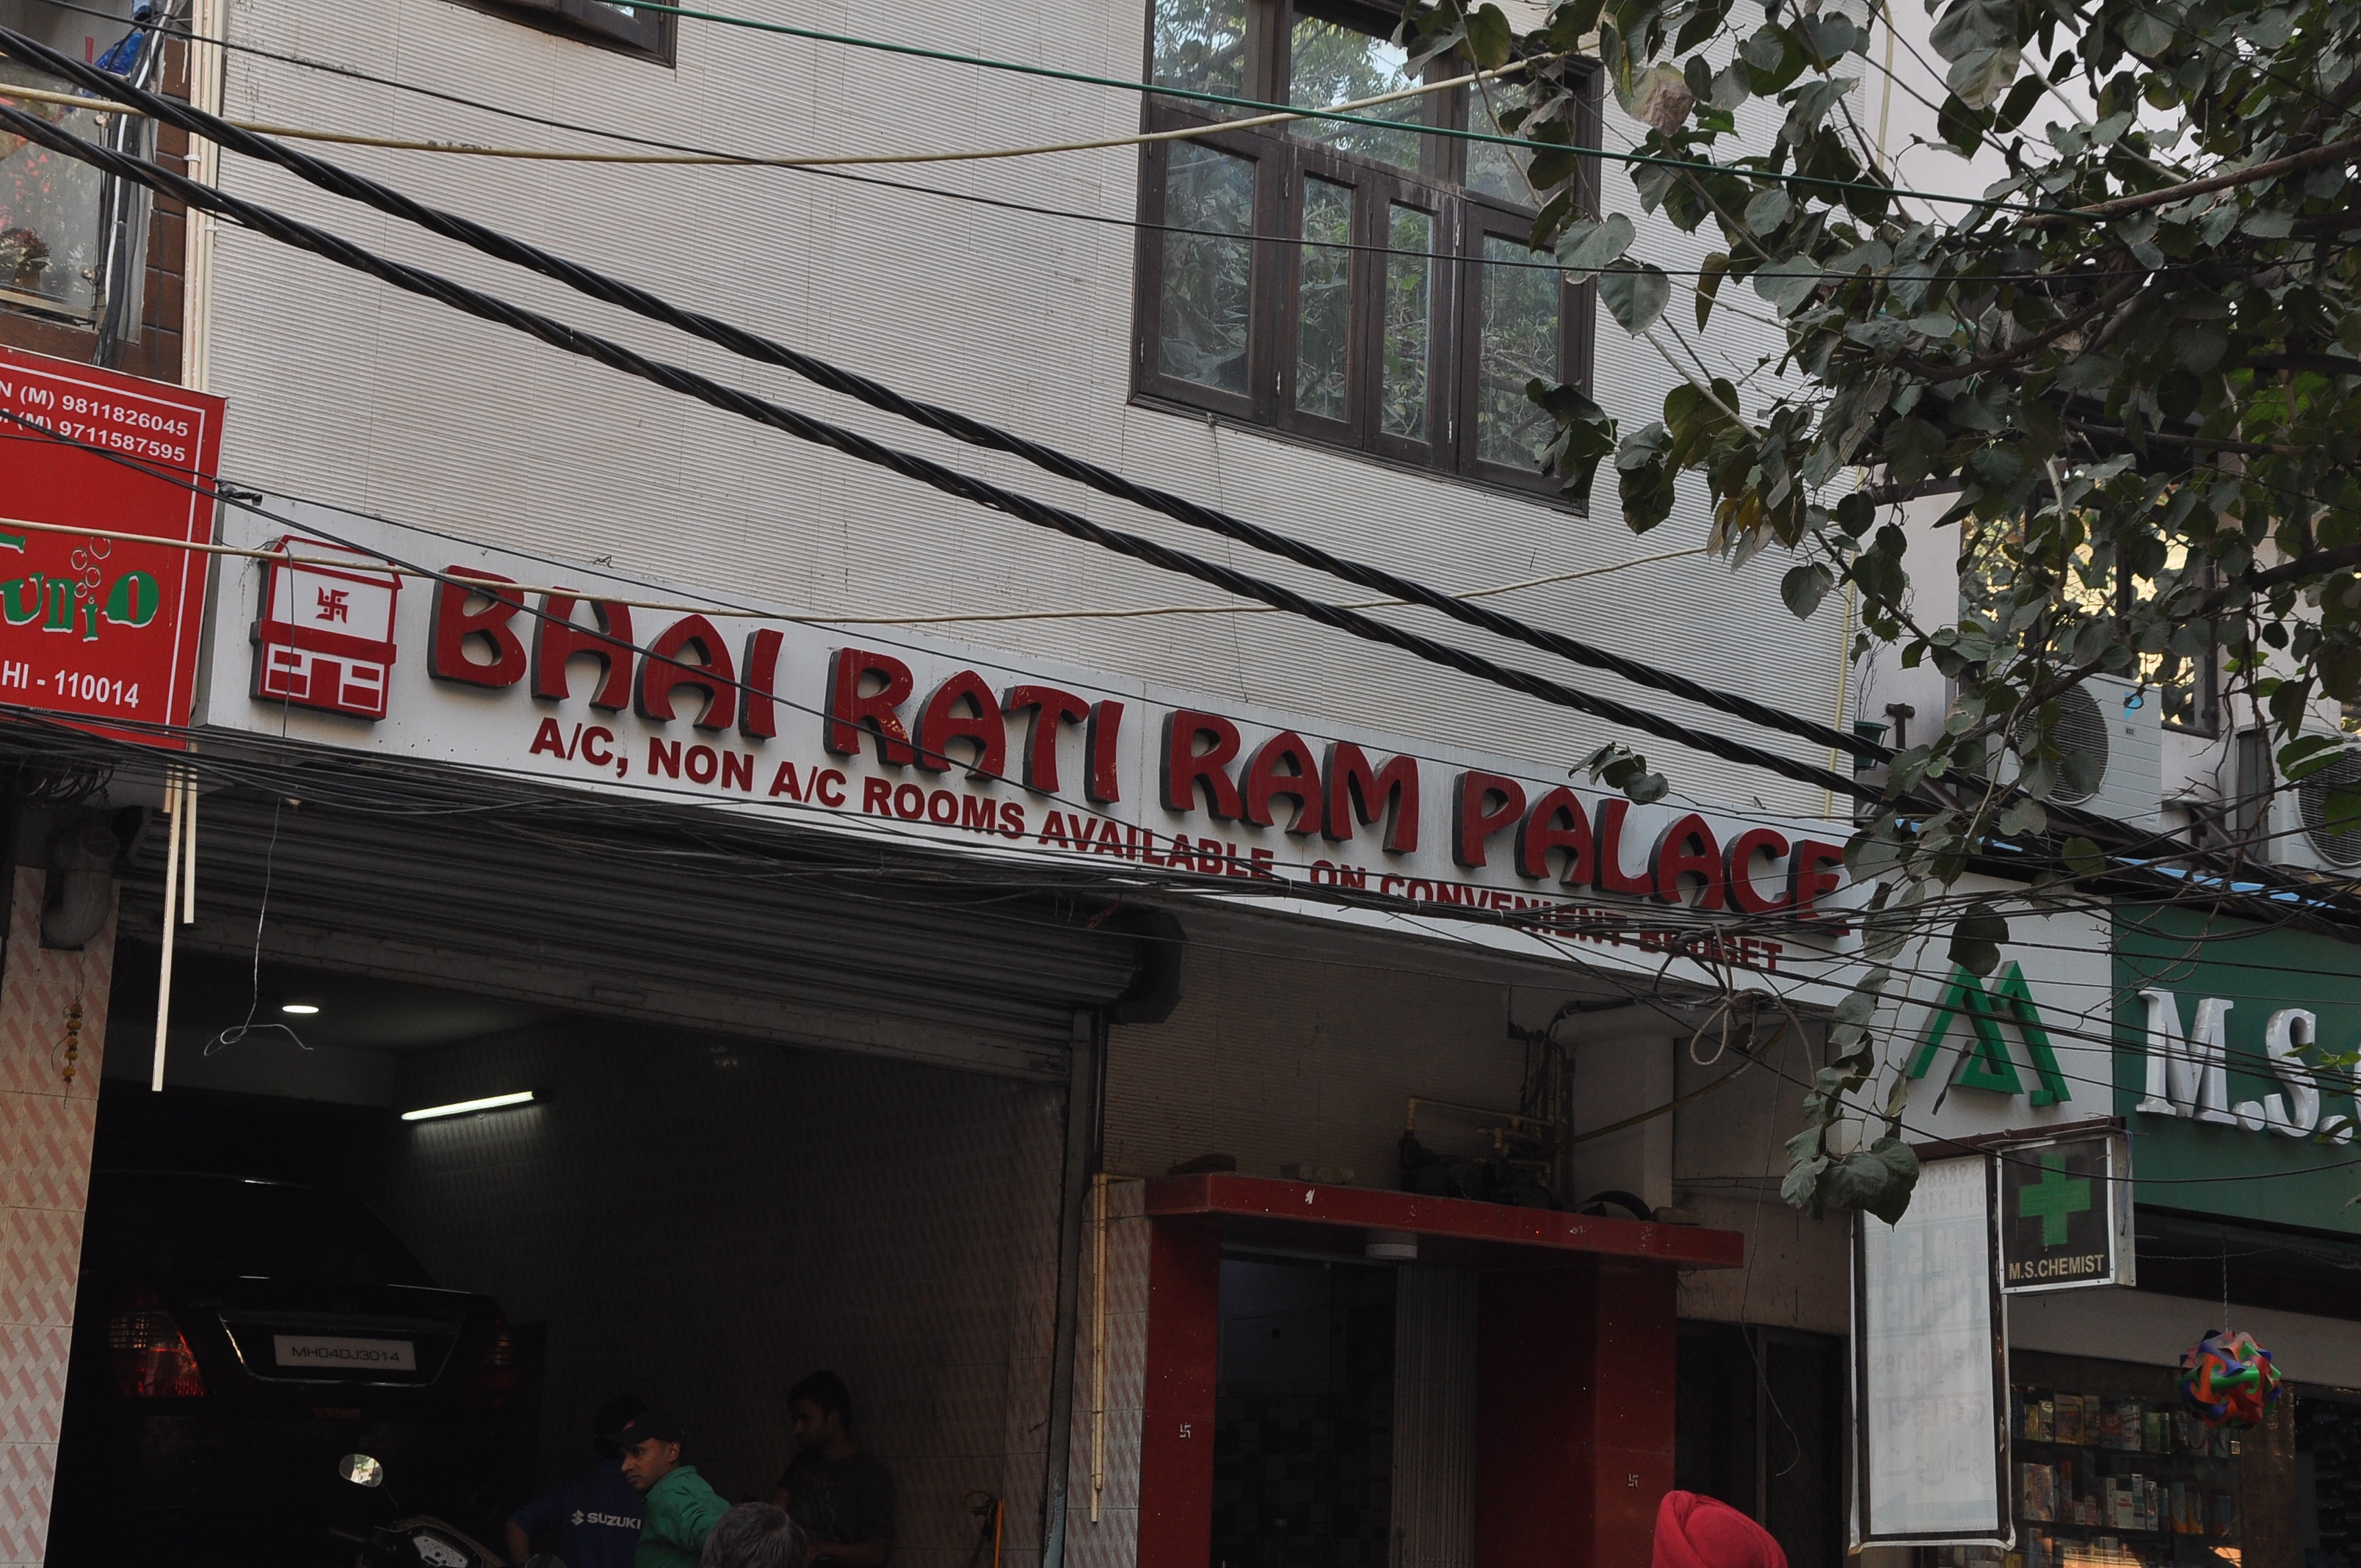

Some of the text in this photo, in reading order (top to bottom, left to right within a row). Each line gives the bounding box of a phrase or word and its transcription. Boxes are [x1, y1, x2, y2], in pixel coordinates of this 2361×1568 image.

[20, 385, 55, 410] (M)
[62, 395, 189, 437] 9811826045
[59, 421, 186, 462] 9711587595
[0, 533, 159, 642] UDiO
[54, 669, 139, 708] 110014
[427, 565, 1852, 938] BHAI RATI RAM PALACE
[529, 716, 628, 778] A/C,
[648, 737, 754, 792] NON
[769, 761, 846, 807] A/C
[863, 776, 1026, 840] ROOMS
[1038, 810, 1274, 881] AVAILABLE
[1310, 860, 1366, 890] ON
[2136, 987, 2361, 1145] M.S.
[2009, 1254, 2104, 1280] M.S.CHEMIST
[291, 1346, 400, 1361] MH04DJ3014
[587, 1512, 642, 1530] SUZUKI
